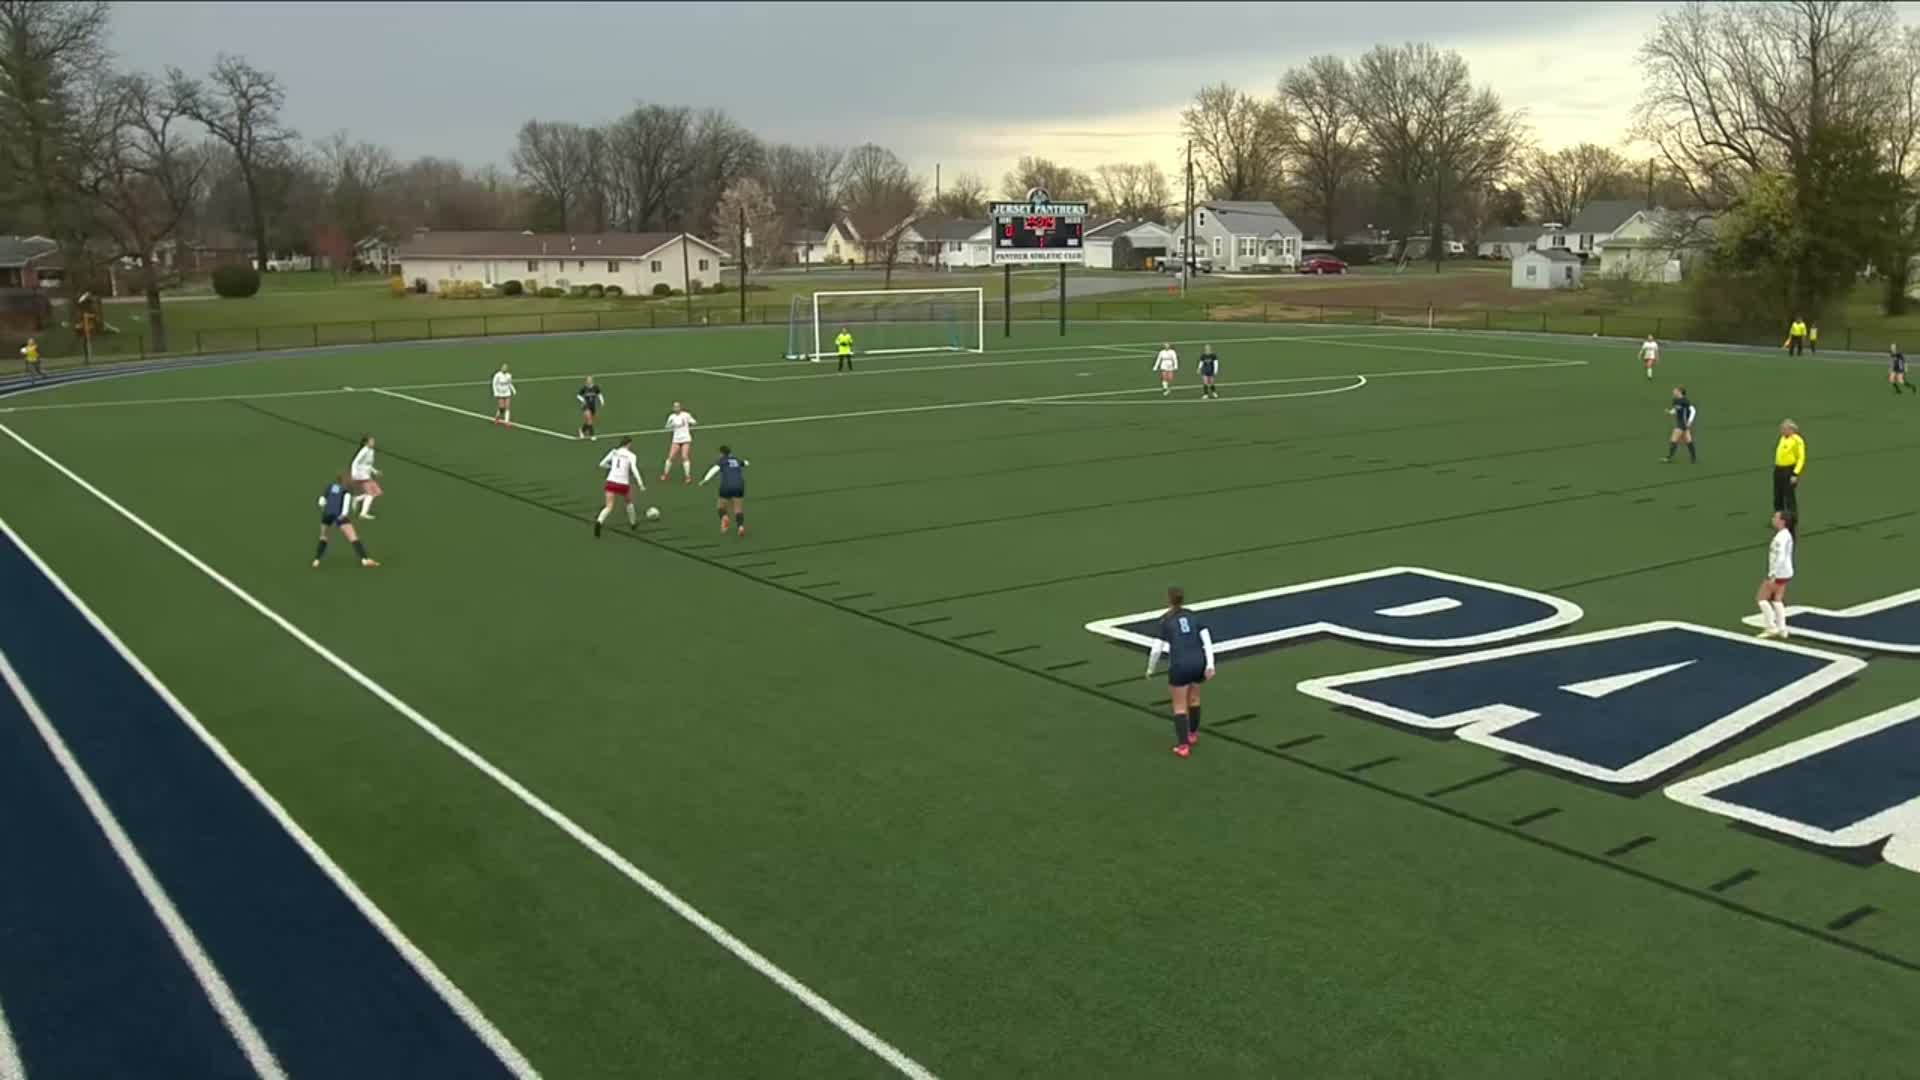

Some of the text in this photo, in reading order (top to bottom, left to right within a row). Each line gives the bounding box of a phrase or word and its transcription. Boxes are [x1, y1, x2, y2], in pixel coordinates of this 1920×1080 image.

[993, 204, 1086, 214] JERSEY PANTHERS
[995, 252, 1082, 260] PANTHER ATHLETIC CLUB
[1178, 617, 1191, 633] 8
